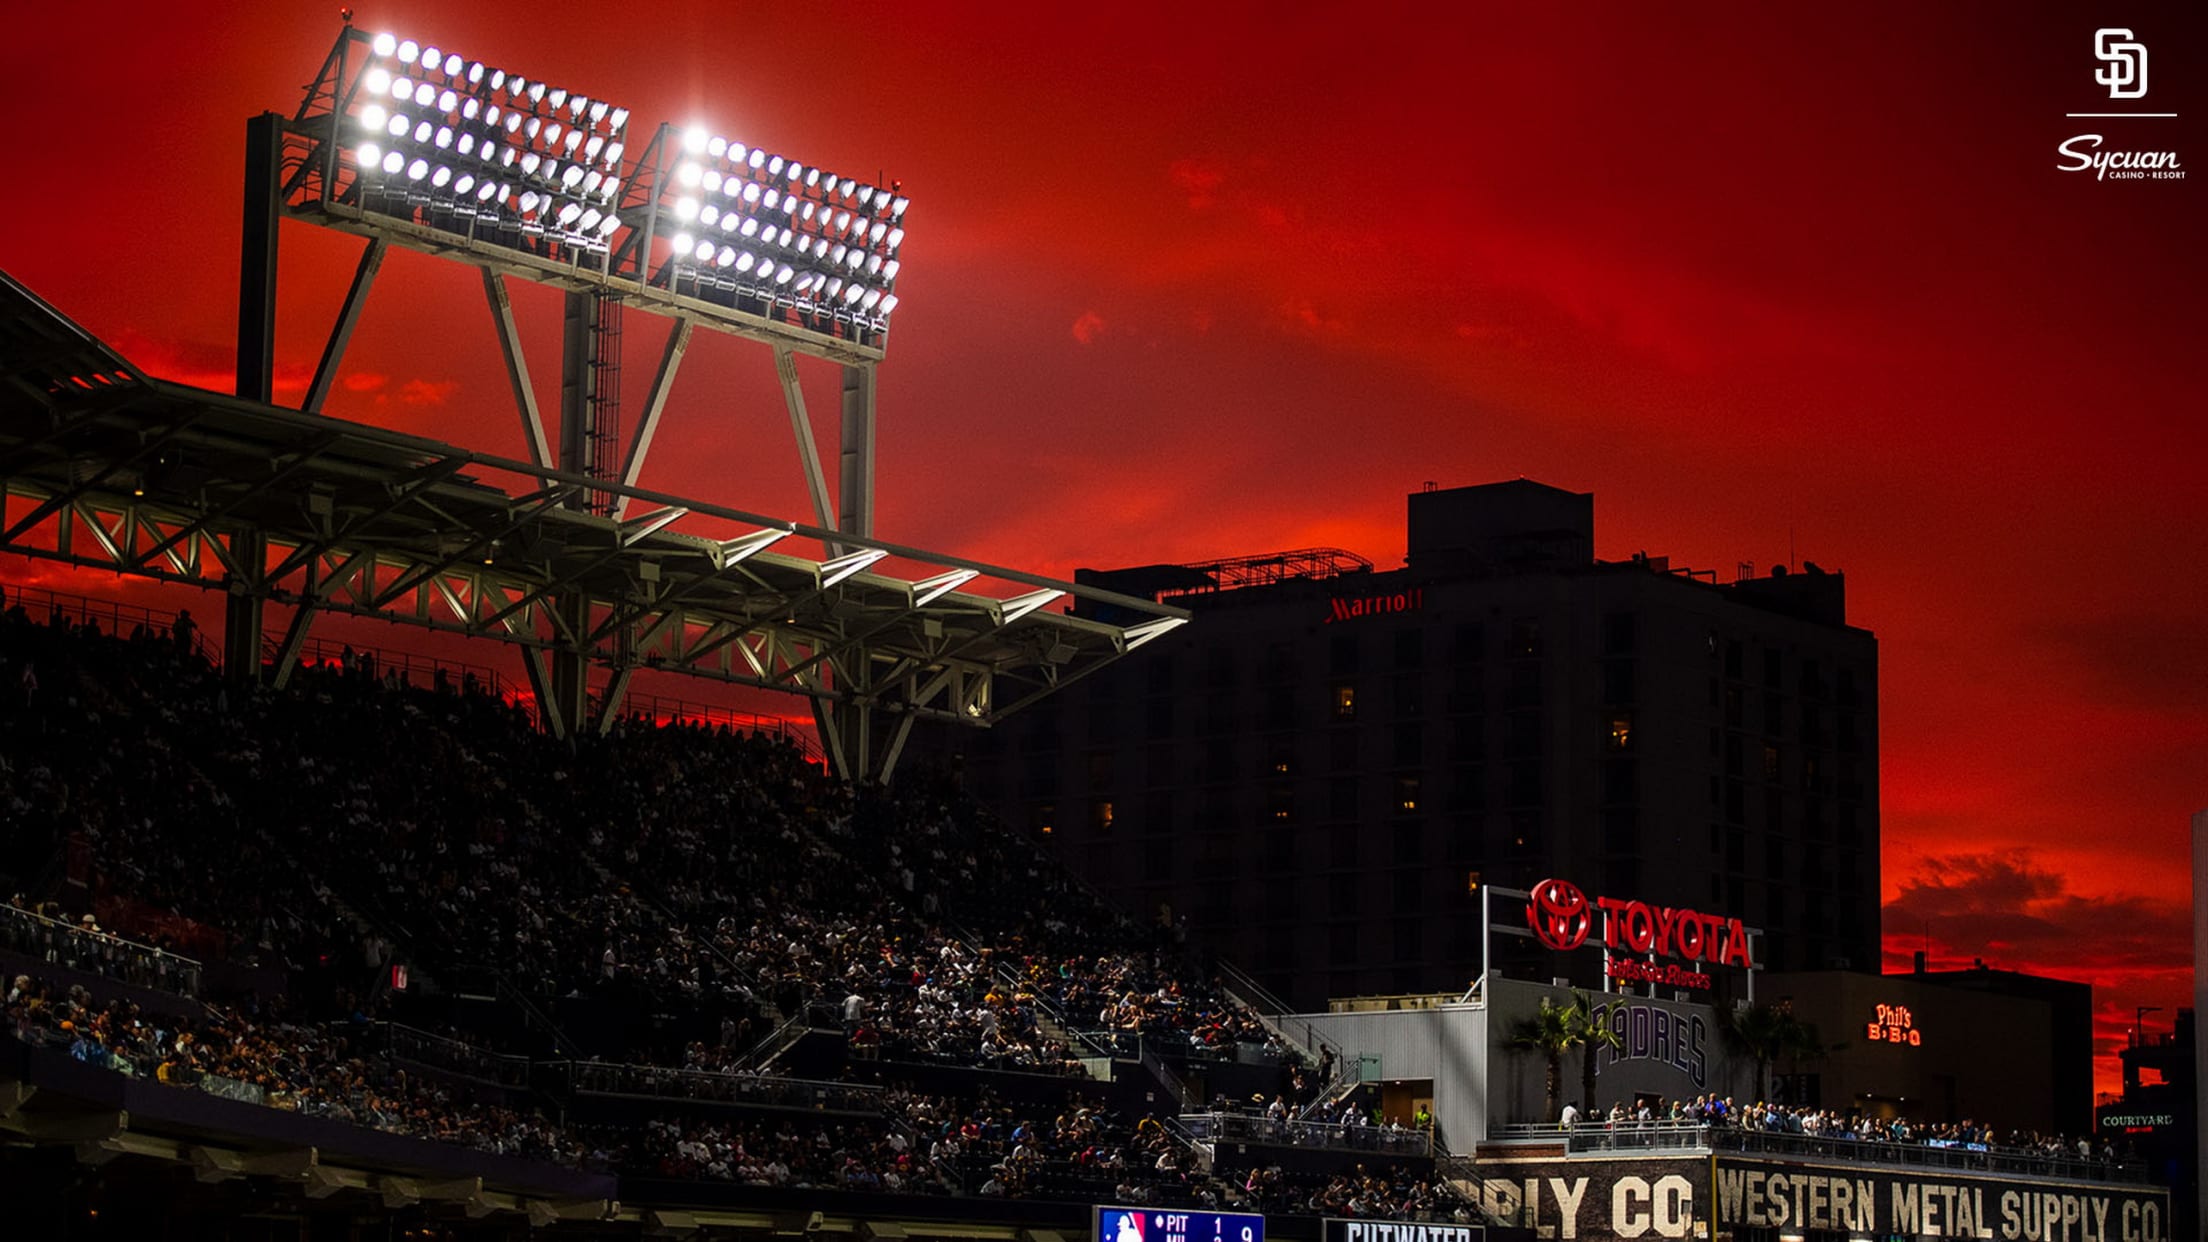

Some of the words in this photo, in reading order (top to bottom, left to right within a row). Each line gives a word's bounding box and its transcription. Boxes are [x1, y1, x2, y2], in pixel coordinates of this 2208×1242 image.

[1598, 896, 1752, 968] TOYOTA
[1876, 1003, 1911, 1029] Phil's
[1590, 1003, 1706, 1090] PADRES
[2102, 1114, 2173, 1127] COURTYARD
[1166, 1215, 1189, 1233] PIT
[1215, 1217, 1221, 1234] 1
[1717, 1168, 1874, 1232] WESTERN
[1892, 1182, 1993, 1239] METAL
[2001, 1190, 2110, 1242] SUPPLY
